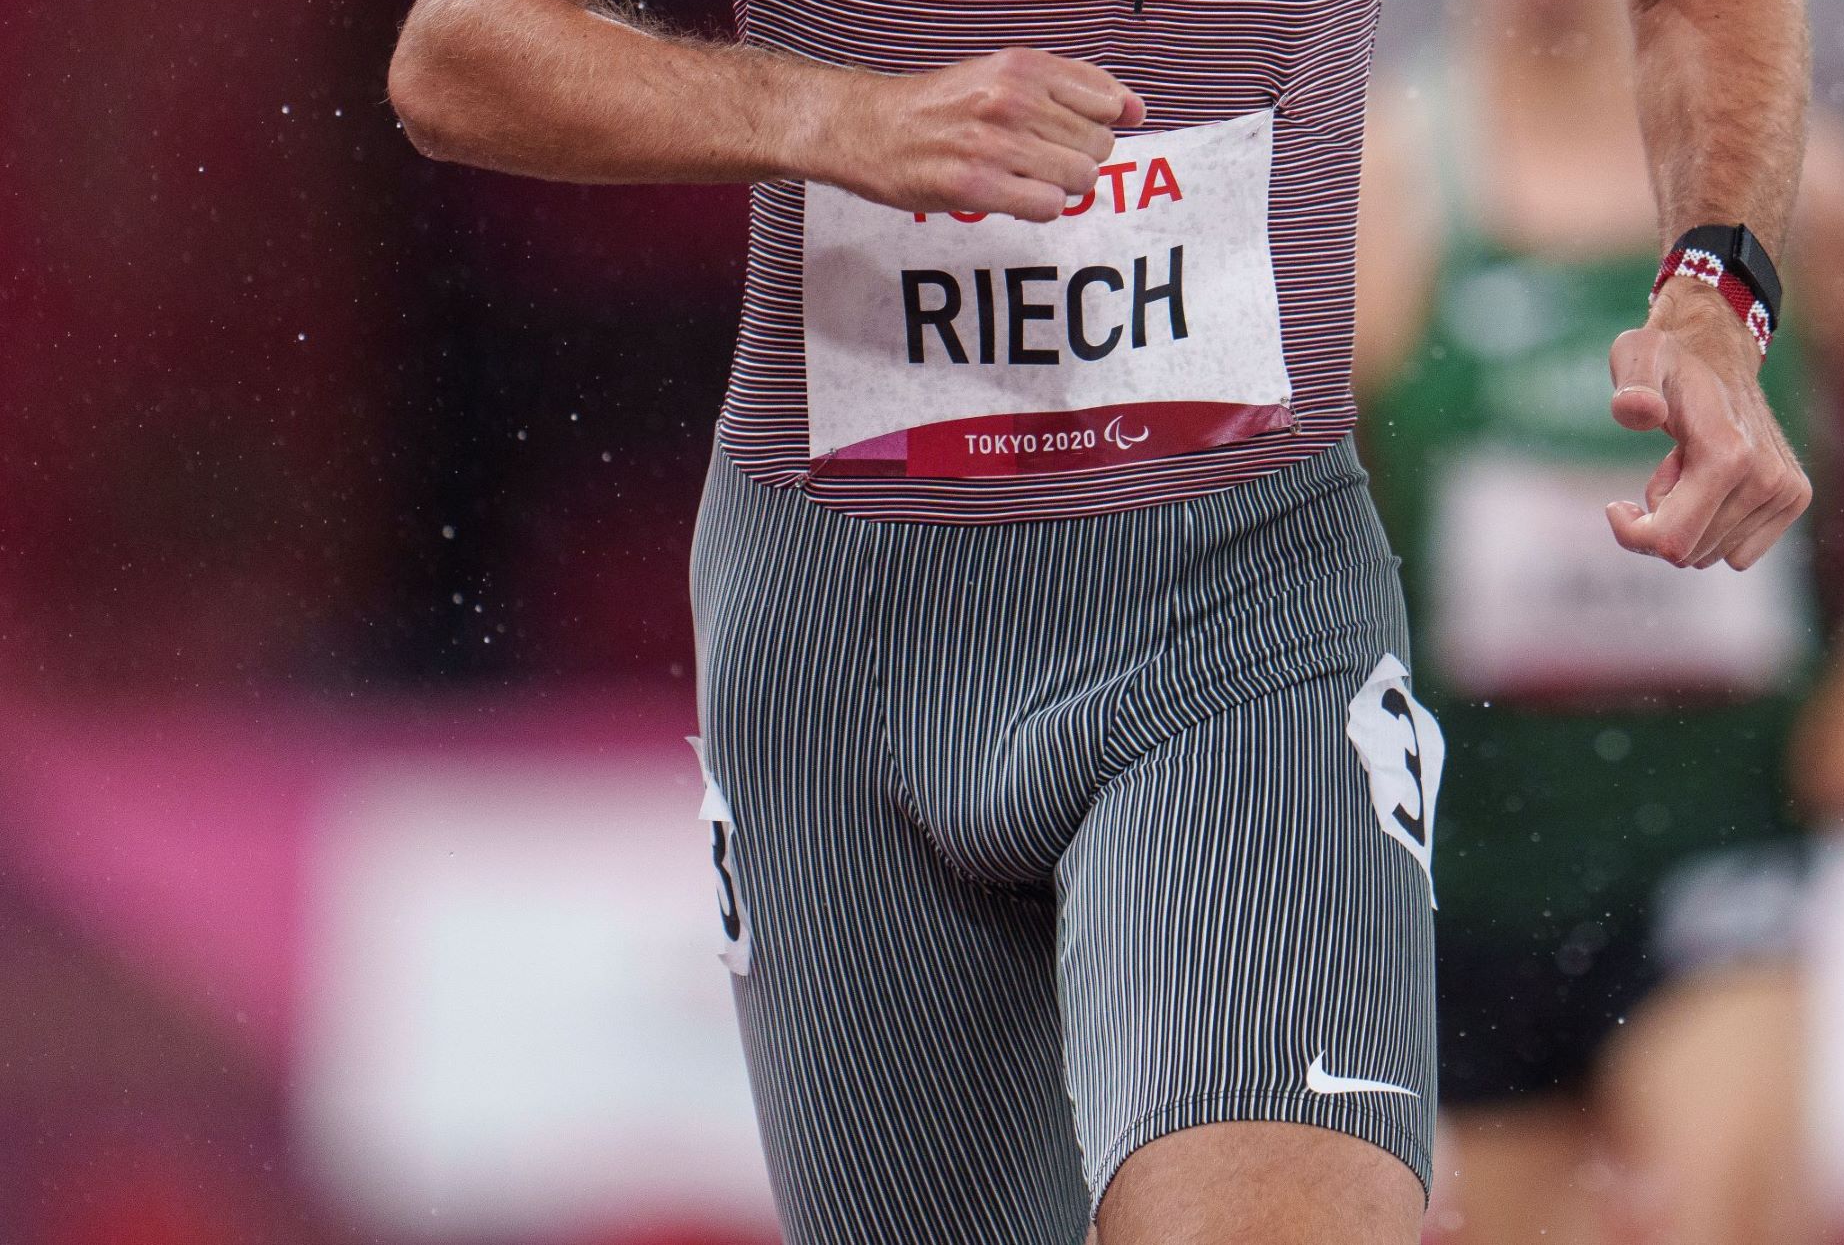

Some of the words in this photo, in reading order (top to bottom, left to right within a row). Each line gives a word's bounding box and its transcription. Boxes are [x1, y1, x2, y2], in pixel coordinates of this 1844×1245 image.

[900, 244, 1190, 366] RIECH
[964, 434, 1037, 455] TOKYO
[1041, 429, 1097, 453] 2020
